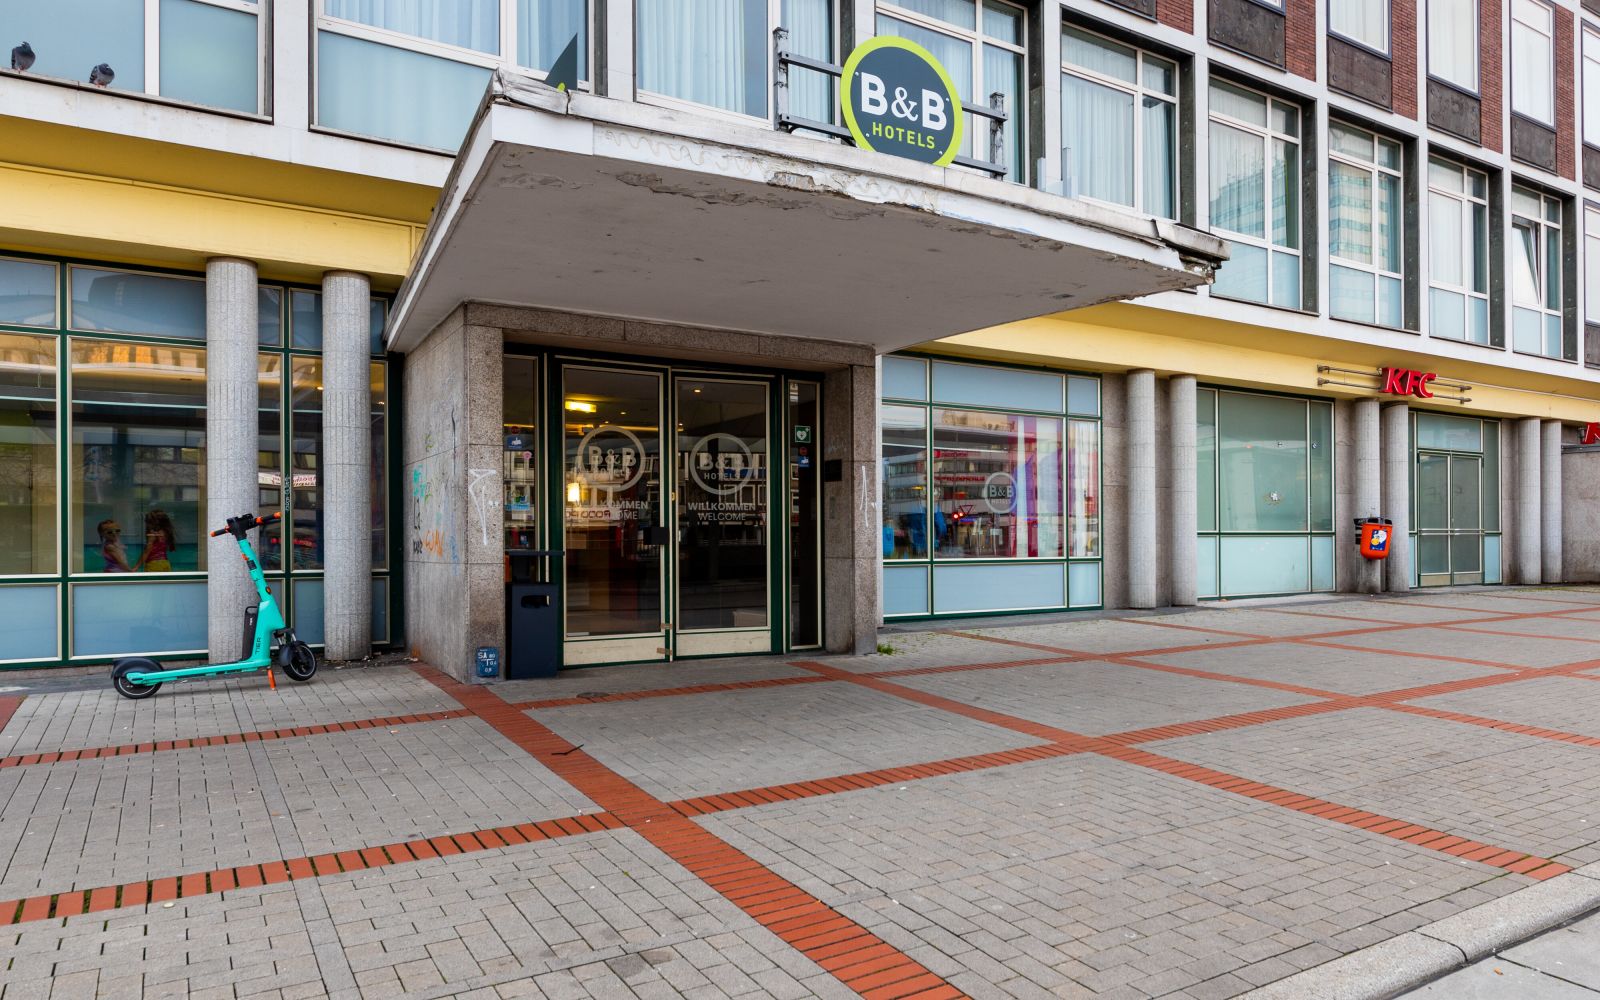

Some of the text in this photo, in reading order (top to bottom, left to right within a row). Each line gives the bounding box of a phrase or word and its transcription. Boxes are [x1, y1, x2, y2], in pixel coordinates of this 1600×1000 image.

[861, 71, 947, 131] B&B
[872, 122, 935, 149] HOTELS
[1380, 367, 1437, 398] KFC
[588, 445, 637, 467] B&B
[990, 485, 1014, 498] B&B
[687, 501, 757, 511] WILLKOMMEN
[697, 512, 747, 521] WELCOME
